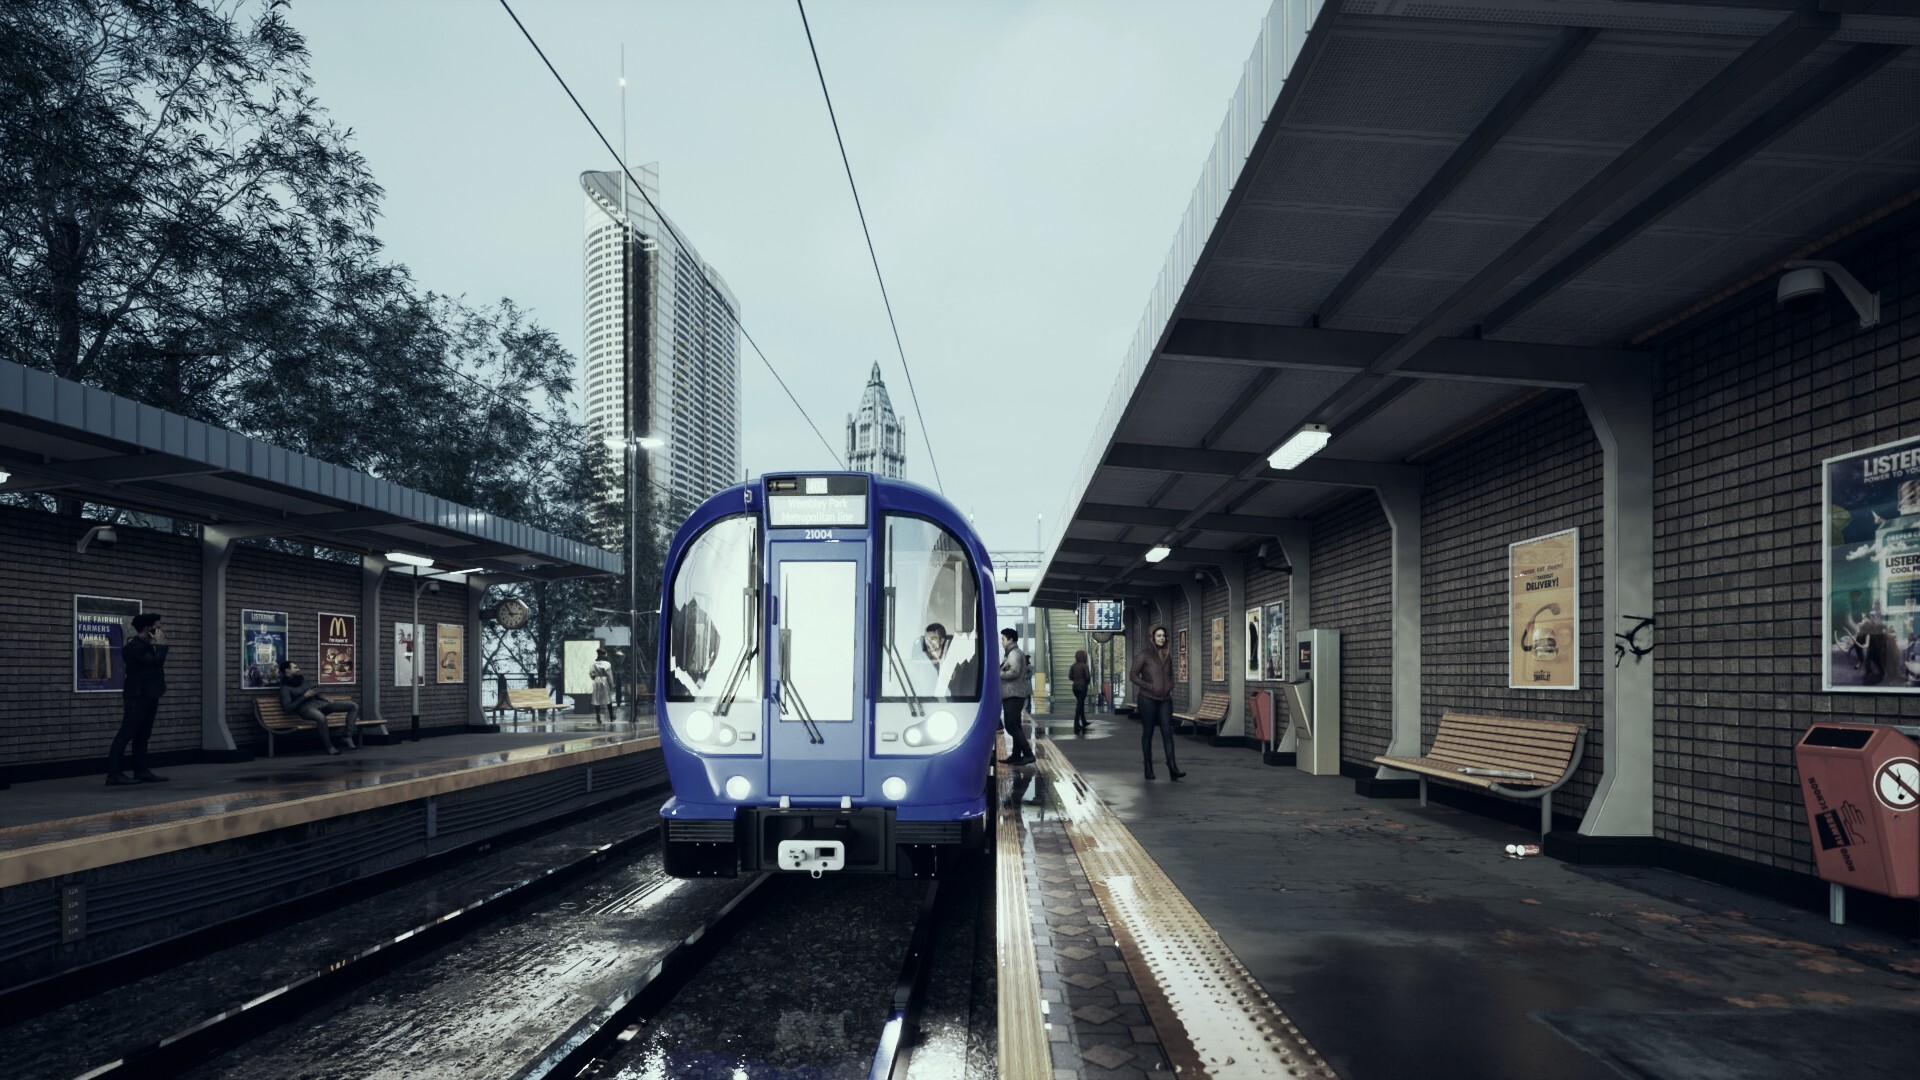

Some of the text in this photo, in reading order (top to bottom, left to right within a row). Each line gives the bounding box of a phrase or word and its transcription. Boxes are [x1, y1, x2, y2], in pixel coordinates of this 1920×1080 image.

[1863, 473, 1890, 484] POWER
[788, 498, 848, 510] Wembley Park
[781, 511, 854, 524] Metropolitan line
[805, 530, 832, 539] 21004
[1890, 566, 1911, 574] COOL
[1526, 577, 1559, 591] DELIVERY!
[93, 616, 123, 624] FAIRHILL
[78, 624, 110, 632] FARMERS
[78, 633, 106, 641] MARKET
[1808, 777, 1828, 810] SCHOON
[1840, 848, 1856, 872] HOUD
